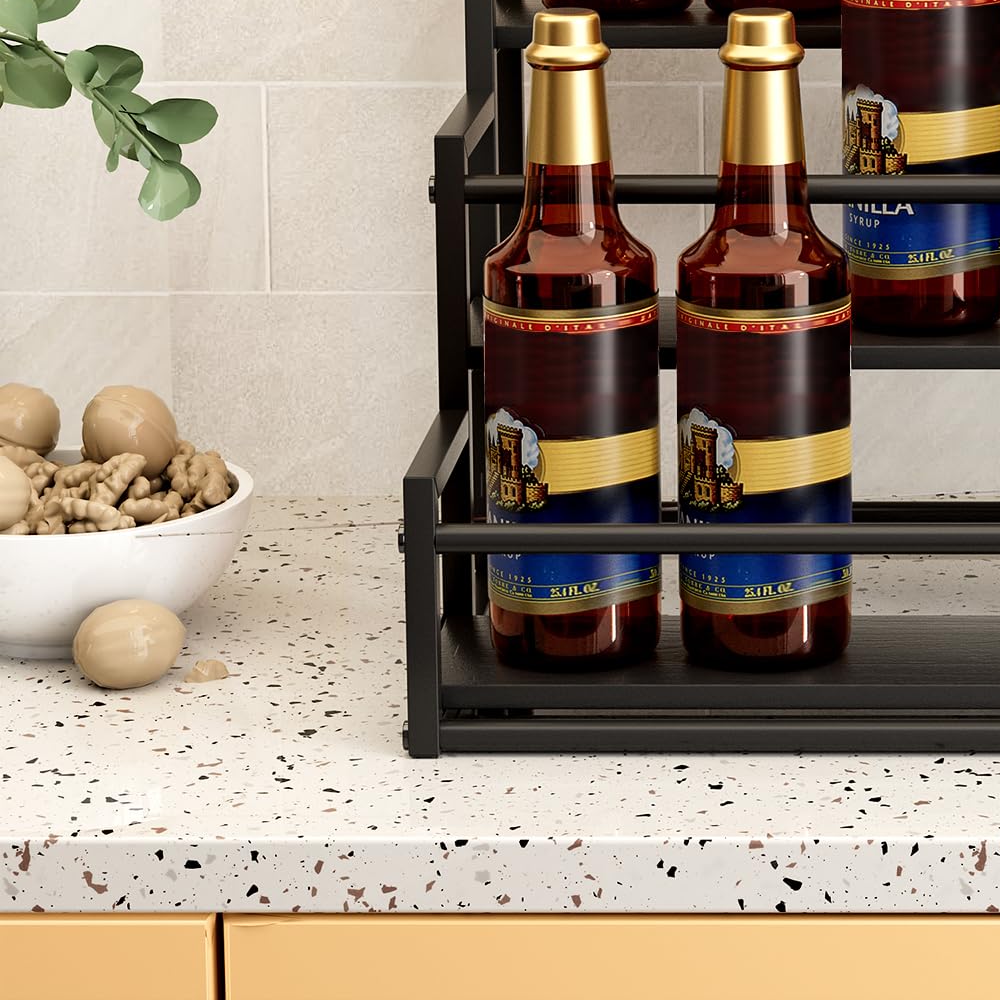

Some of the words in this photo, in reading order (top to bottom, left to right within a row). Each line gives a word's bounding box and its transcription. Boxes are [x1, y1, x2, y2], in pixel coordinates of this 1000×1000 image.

[849, 212, 880, 228] SYRUP
[867, 240, 890, 250] 1925
[508, 573, 532, 584] 1925
[701, 573, 726, 584] 1925
